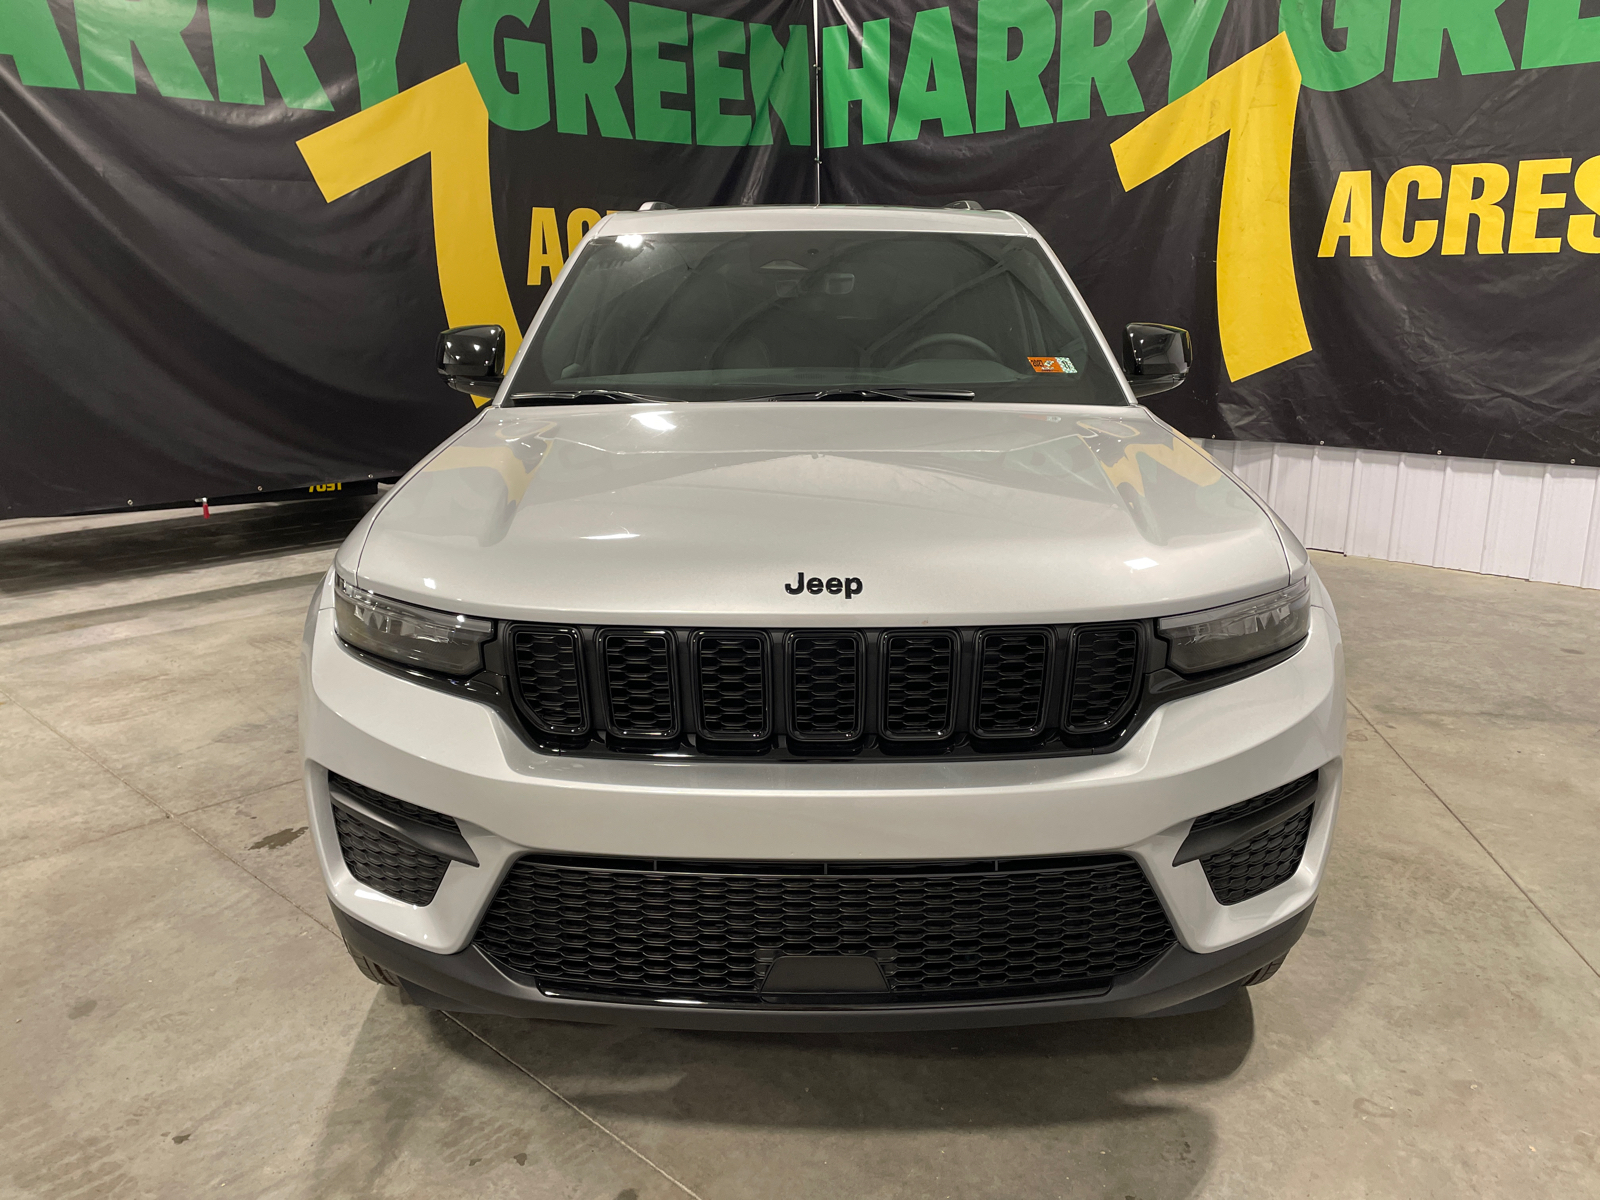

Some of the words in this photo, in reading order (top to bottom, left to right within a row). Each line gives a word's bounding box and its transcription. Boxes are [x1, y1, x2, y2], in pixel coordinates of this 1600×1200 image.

[457, 0, 812, 147] GREEN
[821, 0, 1230, 149] HARRY
[296, 62, 523, 408] 7
[1110, 31, 1312, 382] 7
[784, 571, 864, 599] Jeep
